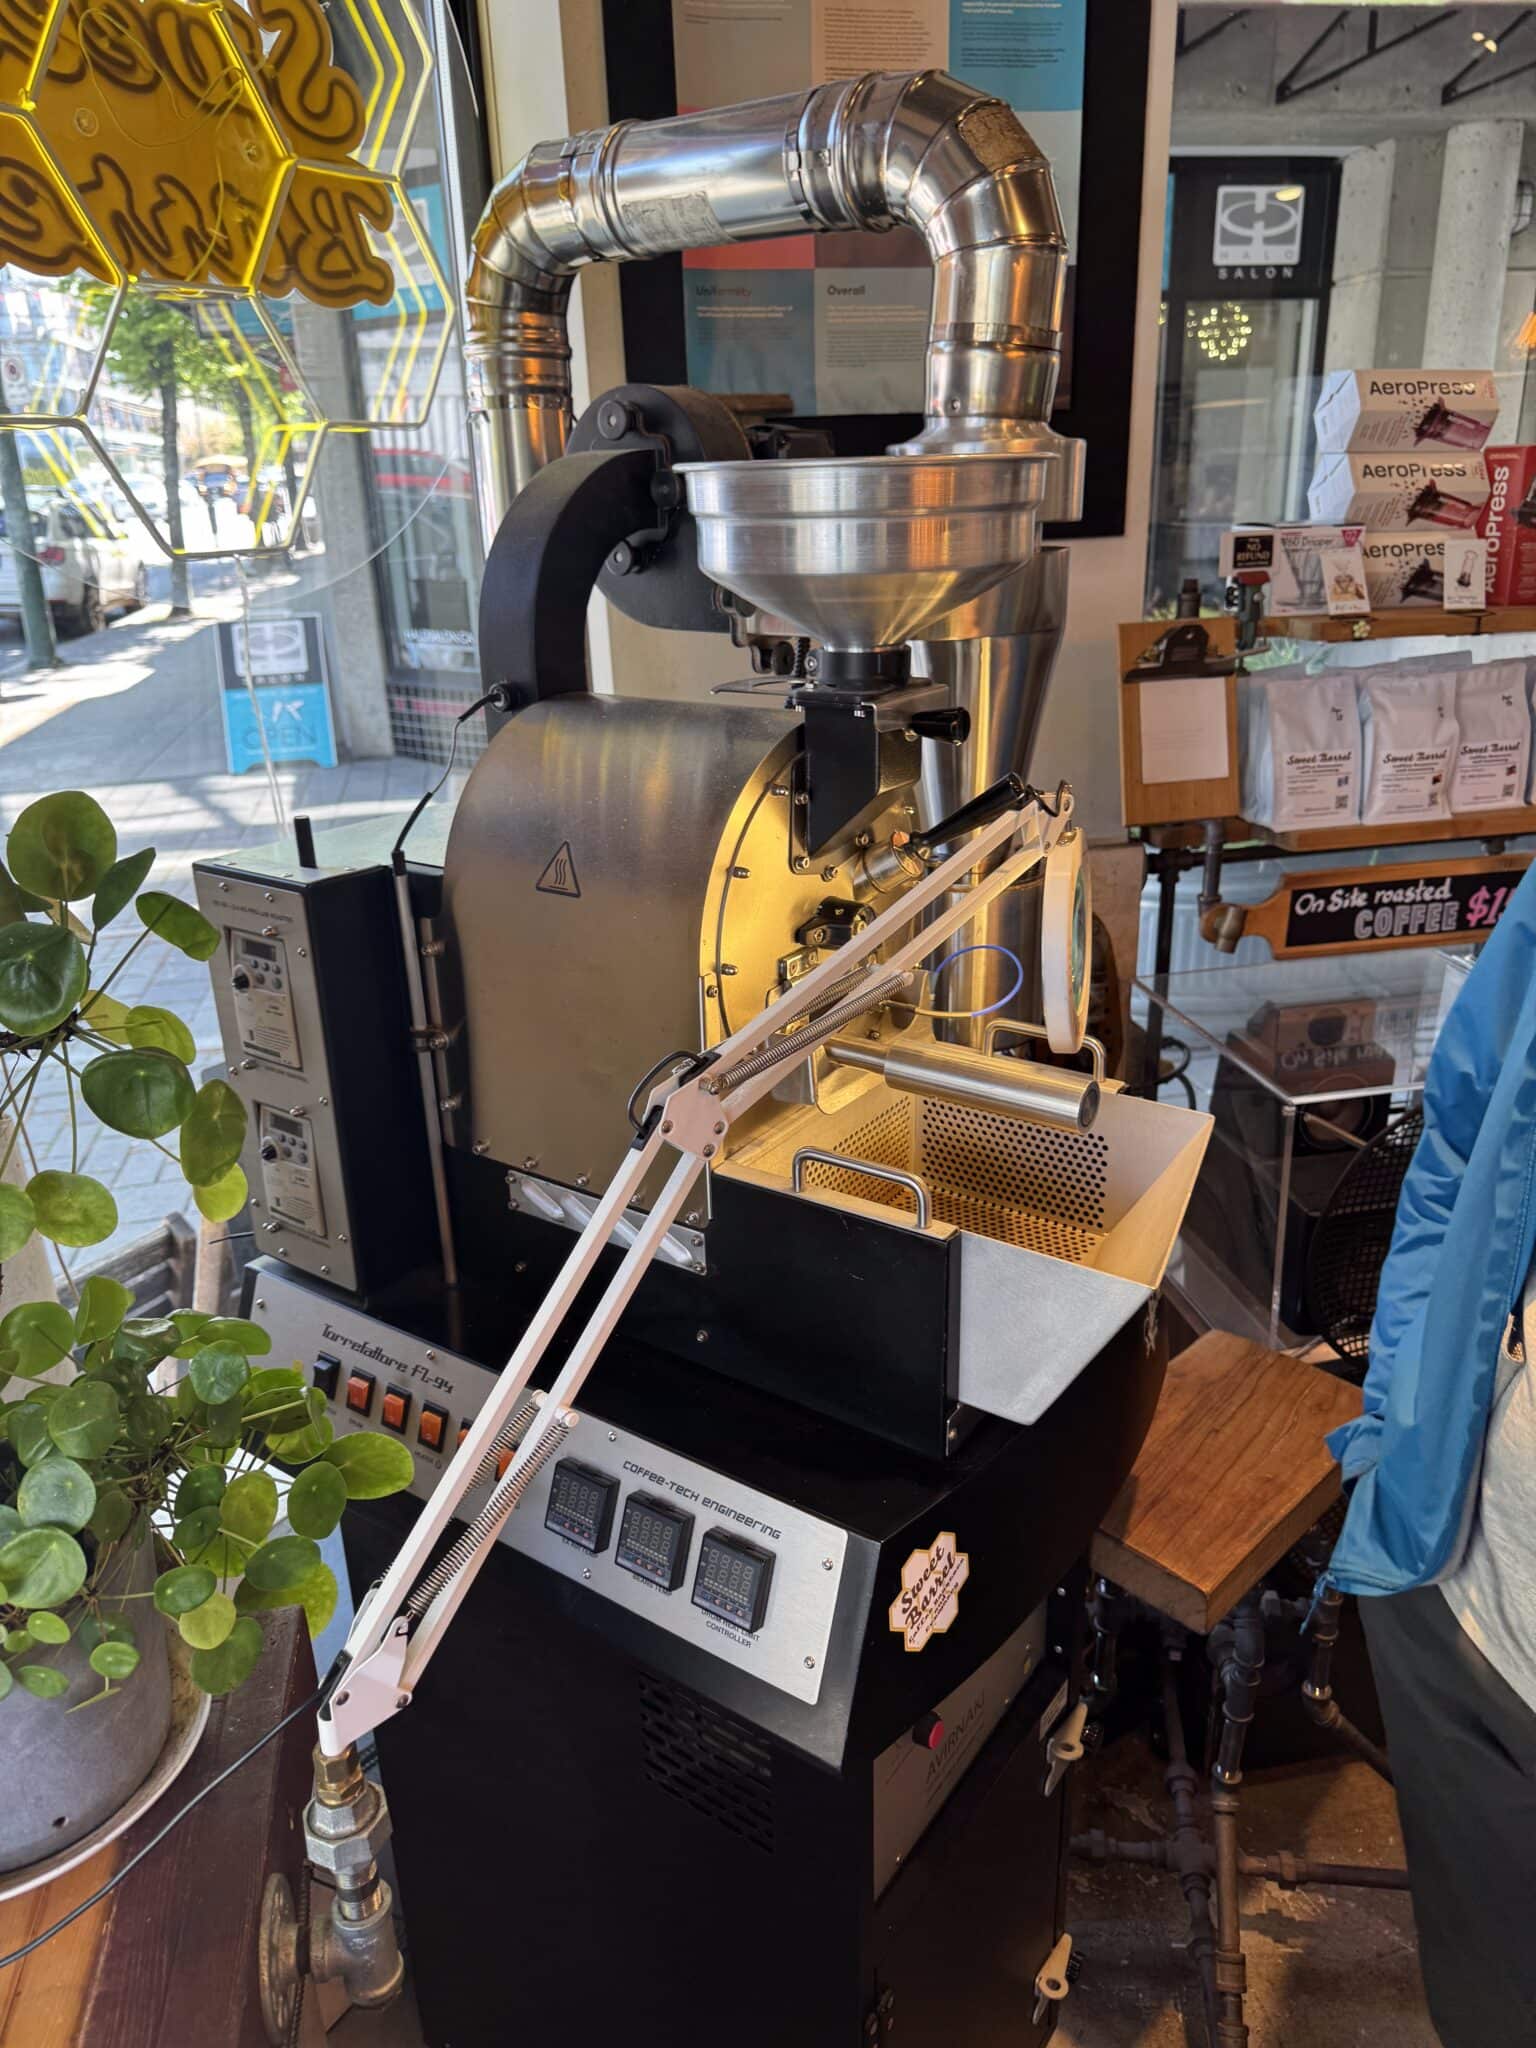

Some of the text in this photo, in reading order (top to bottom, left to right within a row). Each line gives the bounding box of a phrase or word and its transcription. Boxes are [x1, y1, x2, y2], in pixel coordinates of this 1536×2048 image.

[827, 285, 865, 296] Overall
[1218, 267, 1293, 280] SALON
[1369, 380, 1476, 396] AeroPress
[1295, 877, 1453, 916] On Site roasted
[1354, 901, 1460, 940] COFFEE
[321, 1323, 409, 1373] Torrefattore
[622, 1460, 783, 1540] COFFEE-TECH ENGINEERING
[901, 1545, 945, 1615] Sweet
[905, 1551, 956, 1630] Barrel
[705, 1620, 752, 1649] CONTROLLER
